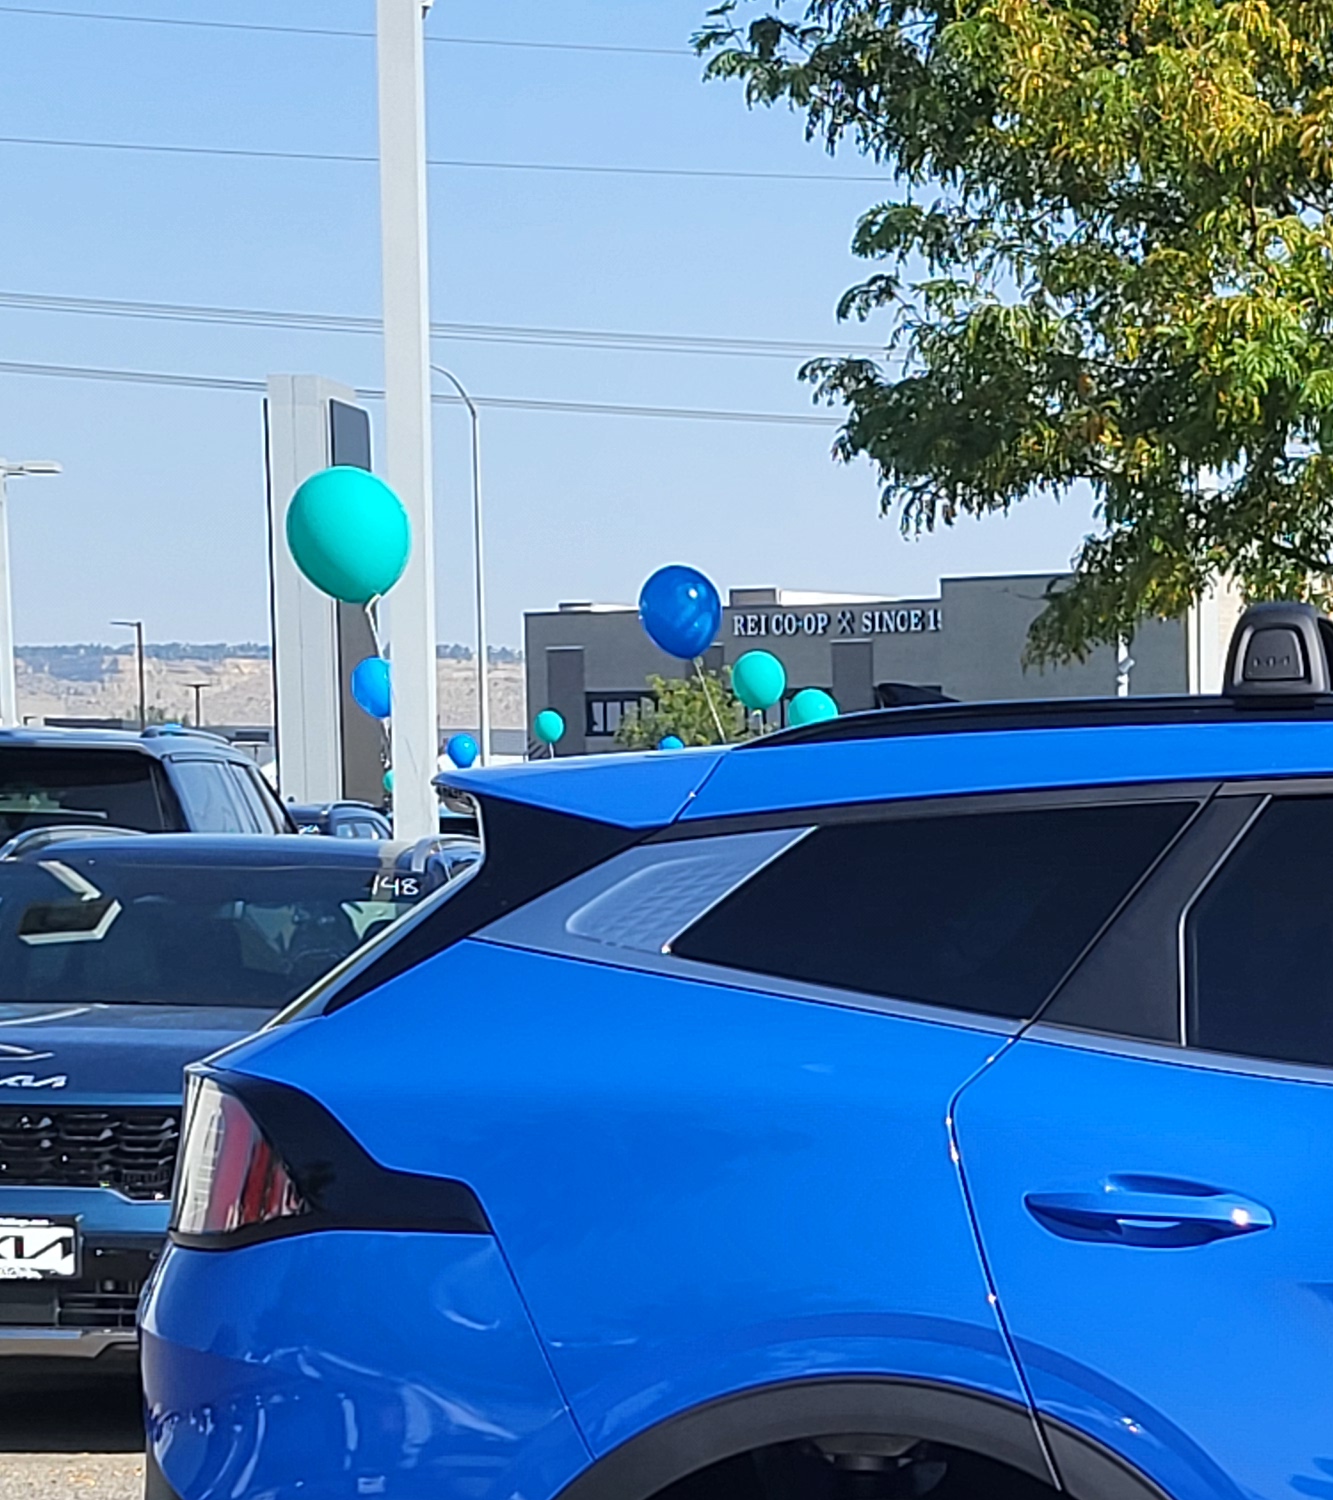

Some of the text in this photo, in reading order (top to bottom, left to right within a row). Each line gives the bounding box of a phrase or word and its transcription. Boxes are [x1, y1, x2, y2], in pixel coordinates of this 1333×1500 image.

[733, 615, 766, 636] REI
[771, 613, 829, 634] CO-OP
[861, 610, 922, 632] SINCE
[372, 875, 419, 896] 148
[0, 1235, 72, 1260] IA
